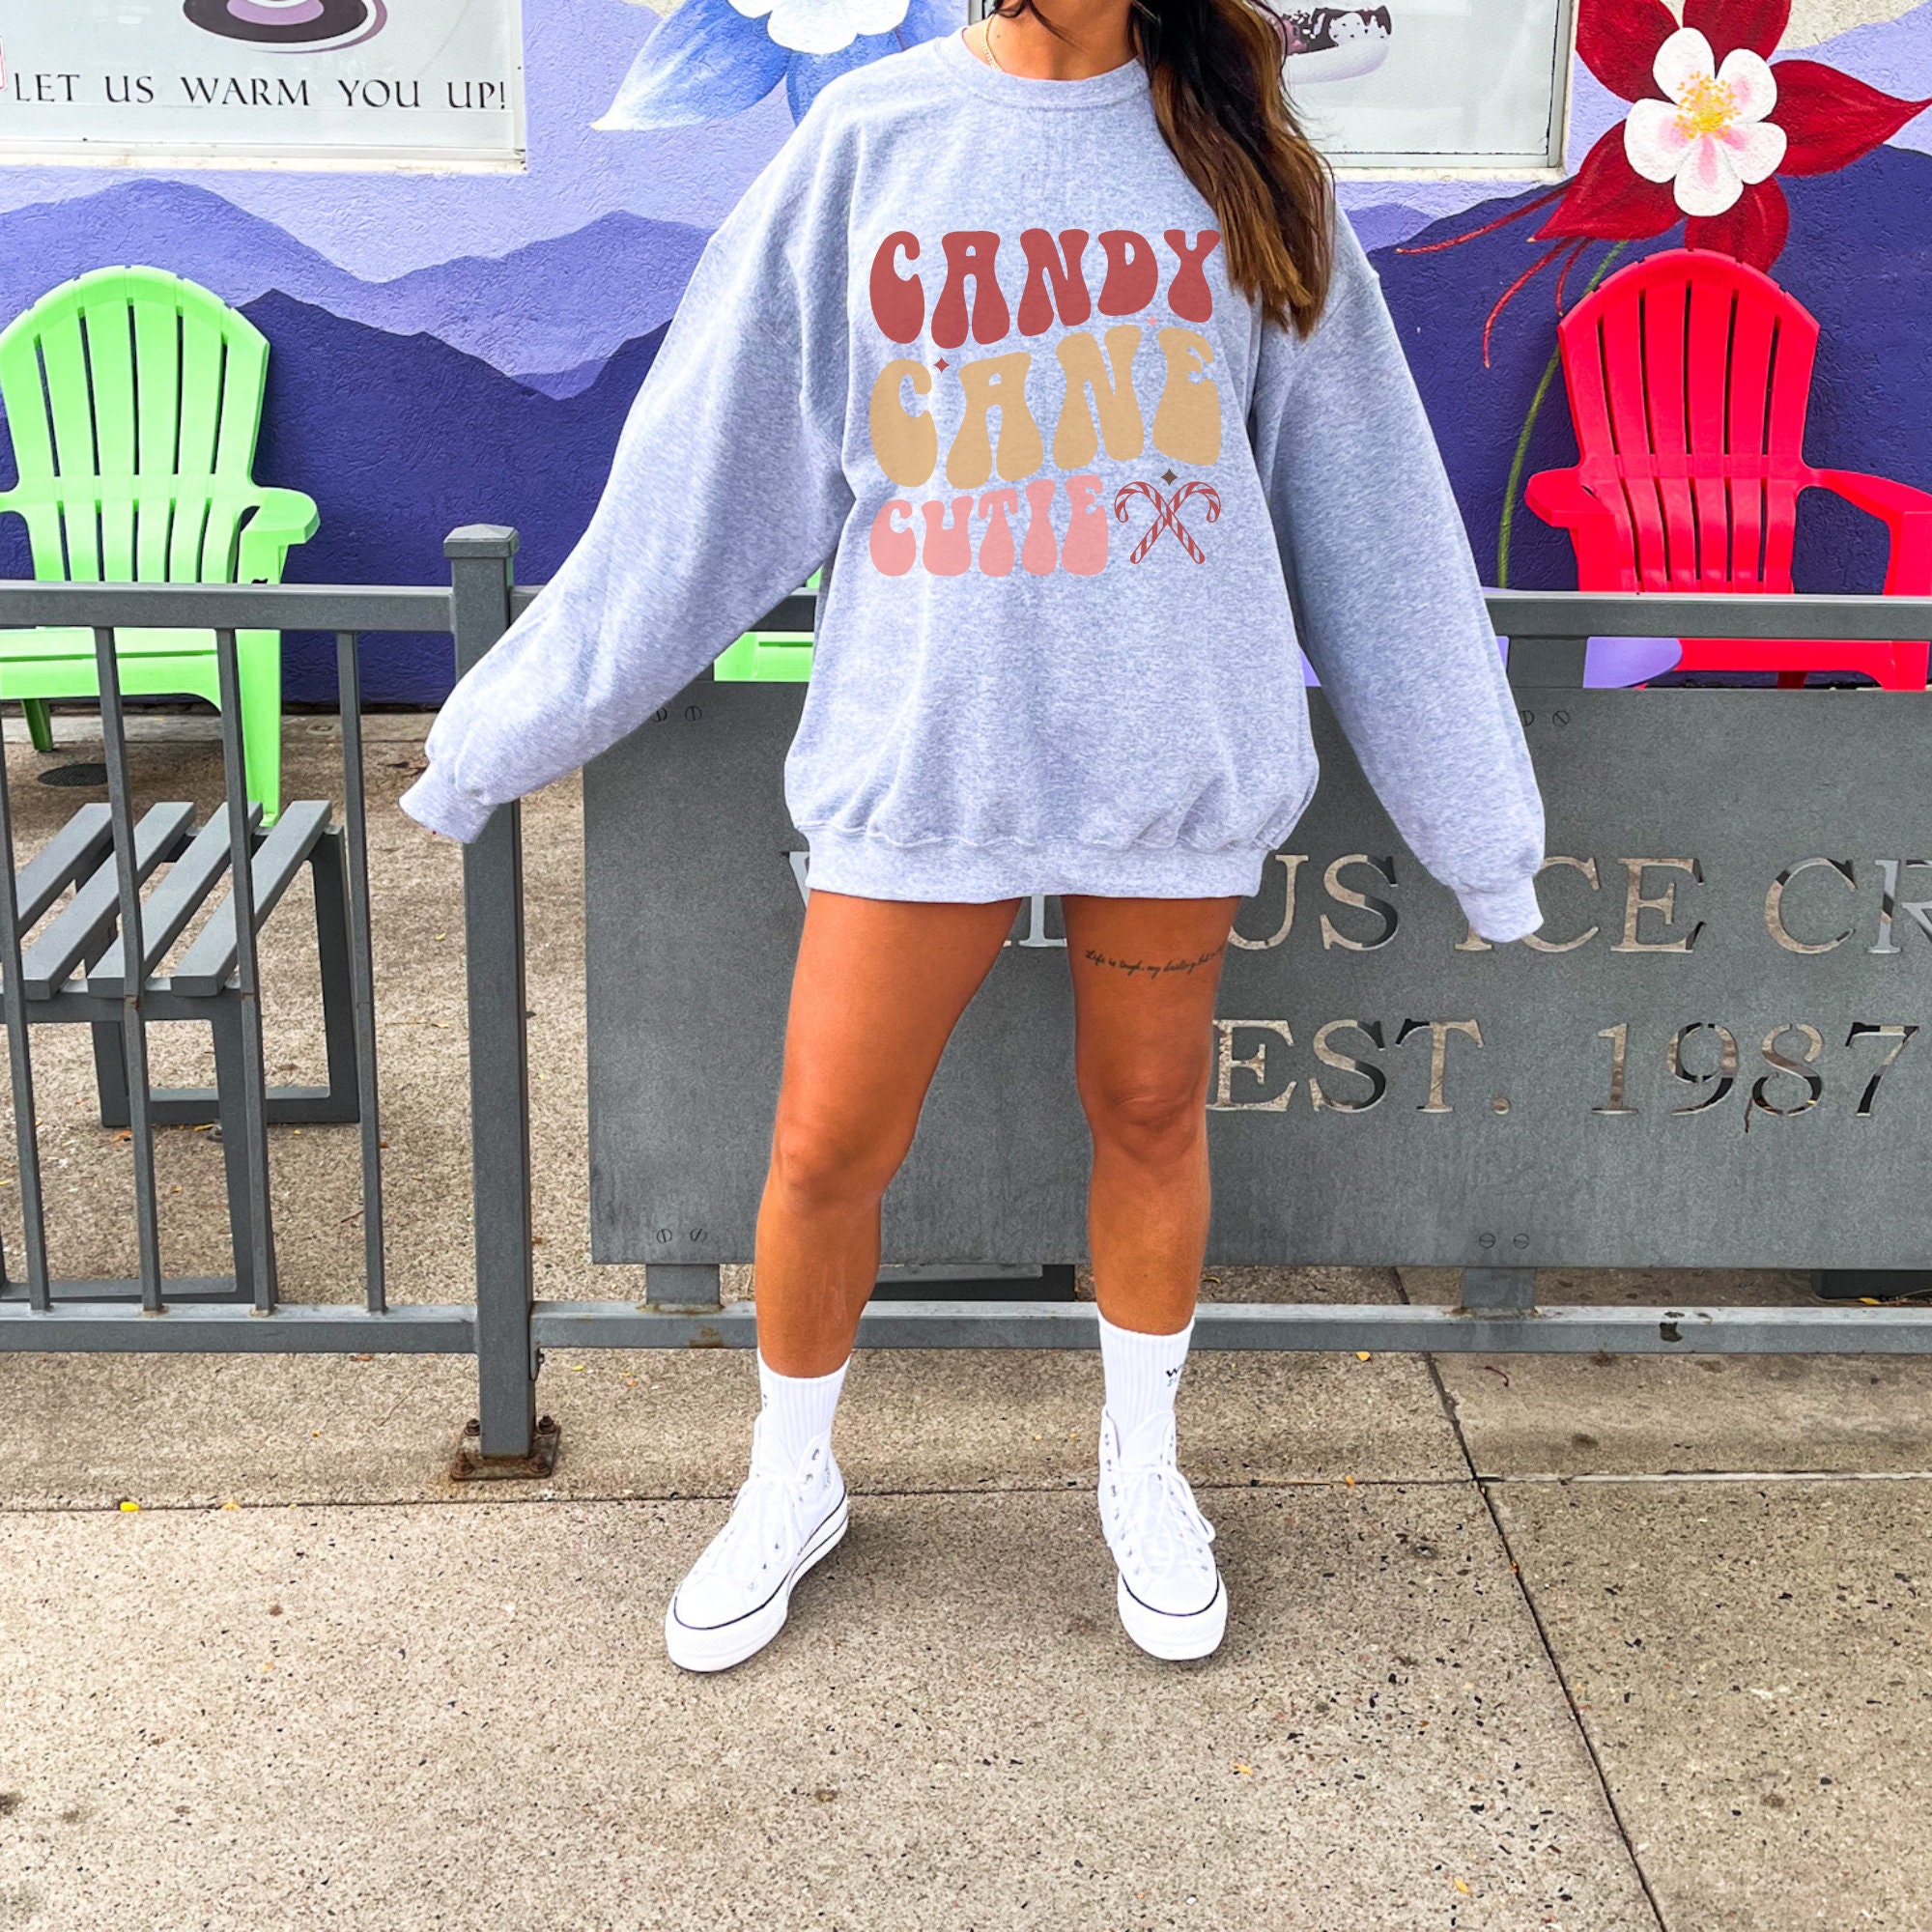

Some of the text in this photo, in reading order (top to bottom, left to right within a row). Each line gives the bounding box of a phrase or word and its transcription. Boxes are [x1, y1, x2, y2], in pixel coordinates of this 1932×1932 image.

[14, 72, 505, 109] LET US WARM YOU UP!
[869, 228, 1221, 349] CANDY
[869, 325, 1222, 490] CANE
[869, 474, 1109, 578] CUTIE
[1455, 856, 1705, 953] CE
[1206, 1019, 1919, 1118] EST. 1987
